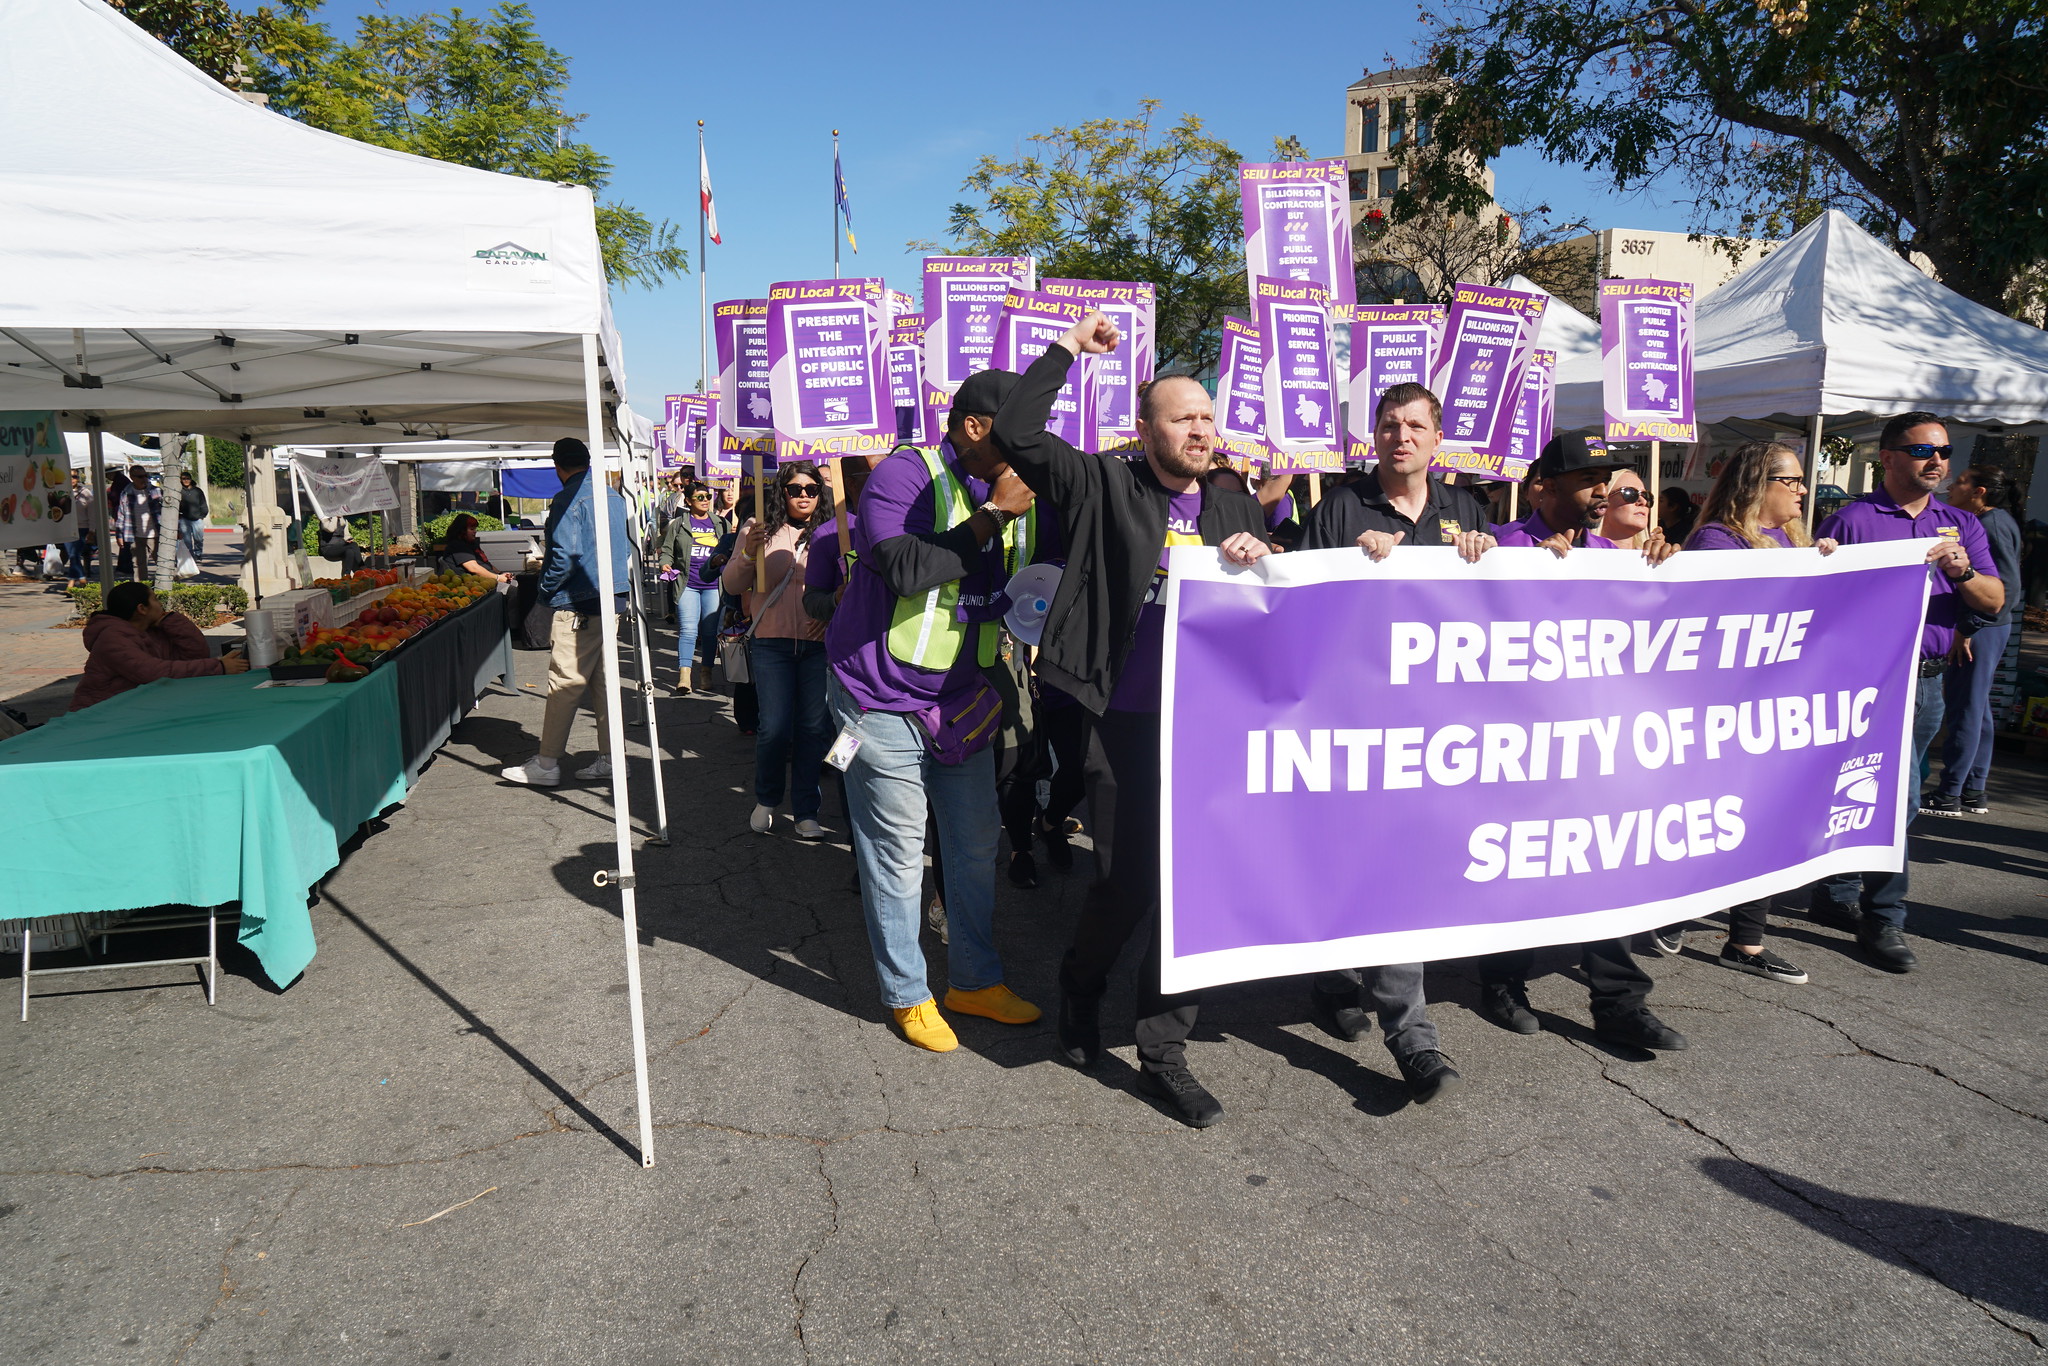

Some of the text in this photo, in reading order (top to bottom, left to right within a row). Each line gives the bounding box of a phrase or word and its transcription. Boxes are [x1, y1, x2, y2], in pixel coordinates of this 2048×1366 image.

[1243, 168, 1325, 179] SEIU Local 721
[1266, 190, 1304, 198] BILLIONS
[1264, 201, 1324, 209] CONTRACTORS
[1621, 239, 1655, 255] 3637
[476, 250, 546, 260] CARAVAN
[1279, 257, 1318, 265] SERVICES
[926, 263, 1009, 272] SEIU Local 721
[770, 285, 860, 300] SEIU Local 721
[1045, 285, 1133, 299] SEIU Local 721
[1259, 283, 1322, 300] SEIU Local 721
[1603, 285, 1677, 297] SEIU Local 721
[1456, 290, 1525, 310] SEIU Local 721
[717, 305, 743, 316] SEIU
[1028, 298, 1060, 313] Local
[1063, 303, 1082, 317] 721
[1634, 307, 1671, 315] PRIORITIZE
[797, 315, 859, 327] PRESERVE
[1283, 313, 1319, 324] PRIORITIZE
[1381, 311, 1409, 321] Local
[1412, 311, 1429, 320] 721
[897, 318, 919, 327] SEIU
[1226, 321, 1242, 332] SEIU
[1467, 320, 1514, 333] BILLIONS FOR
[1643, 318, 1666, 326] PUBLIC
[818, 331, 842, 341] THE
[1291, 327, 1315, 336] PUBLIC
[1639, 329, 1669, 337] SERVICES
[897, 333, 914, 342] 721
[1383, 334, 1416, 343] PUBLIC
[1462, 333, 1513, 346] CONTRACTORS
[1288, 340, 1319, 350] SERVICES
[1646, 340, 1664, 348] OVER
[799, 345, 863, 358] INTEGRITY
[1021, 344, 1048, 356] SERV
[1375, 347, 1423, 357] SERVANTS
[1477, 349, 1493, 357] BUT
[1642, 351, 1668, 359] GREEDY
[891, 353, 904, 361] LIC
[1296, 354, 1315, 363] OVER
[1532, 354, 1541, 362] 21
[801, 360, 864, 373] OF PUBLIC
[891, 364, 913, 372] ANTS
[1240, 364, 1262, 373] SERVICE
[1386, 361, 1412, 369] OVER
[1629, 362, 1677, 371] CONTRACTORS
[1293, 367, 1319, 376] GREEDY
[805, 376, 863, 388] SERVICES
[893, 376, 903, 384] ER
[1099, 375, 1126, 386] URES
[1379, 374, 1417, 383] PRIVATE
[1471, 374, 1486, 383] FOR
[1283, 380, 1328, 390] CONTRACTORS
[1231, 390, 1264, 401] CONTRACTO
[1462, 386, 1487, 396] PUBLIC
[929, 392, 949, 405] IN
[1454, 398, 1487, 408] SERVICES
[1051, 399, 1077, 412] URES
[826, 413, 849, 421] SEIU
[1512, 427, 1529, 435] RVICES
[1608, 422, 1693, 438] IN ACTION!
[723, 437, 775, 452] IN ACTI
[781, 433, 895, 456] IN ACTION!
[1350, 443, 1370, 456] IN
[1273, 451, 1344, 469] IN ACTION!
[1430, 452, 1503, 470] ACTION!
[1501, 466, 1528, 479] ACTI
[1168, 517, 1195, 532] CAL
[691, 547, 712, 556] EIU
[959, 594, 984, 606] #UNIO
[1390, 610, 1814, 685] PRESERVE THE
[1247, 687, 1878, 794] INTEGRITY OF PUBLIC
[1840, 752, 1883, 773] LOCAL 721
[1824, 806, 1875, 838] SEIU
[1463, 794, 1746, 882] SERVICES
